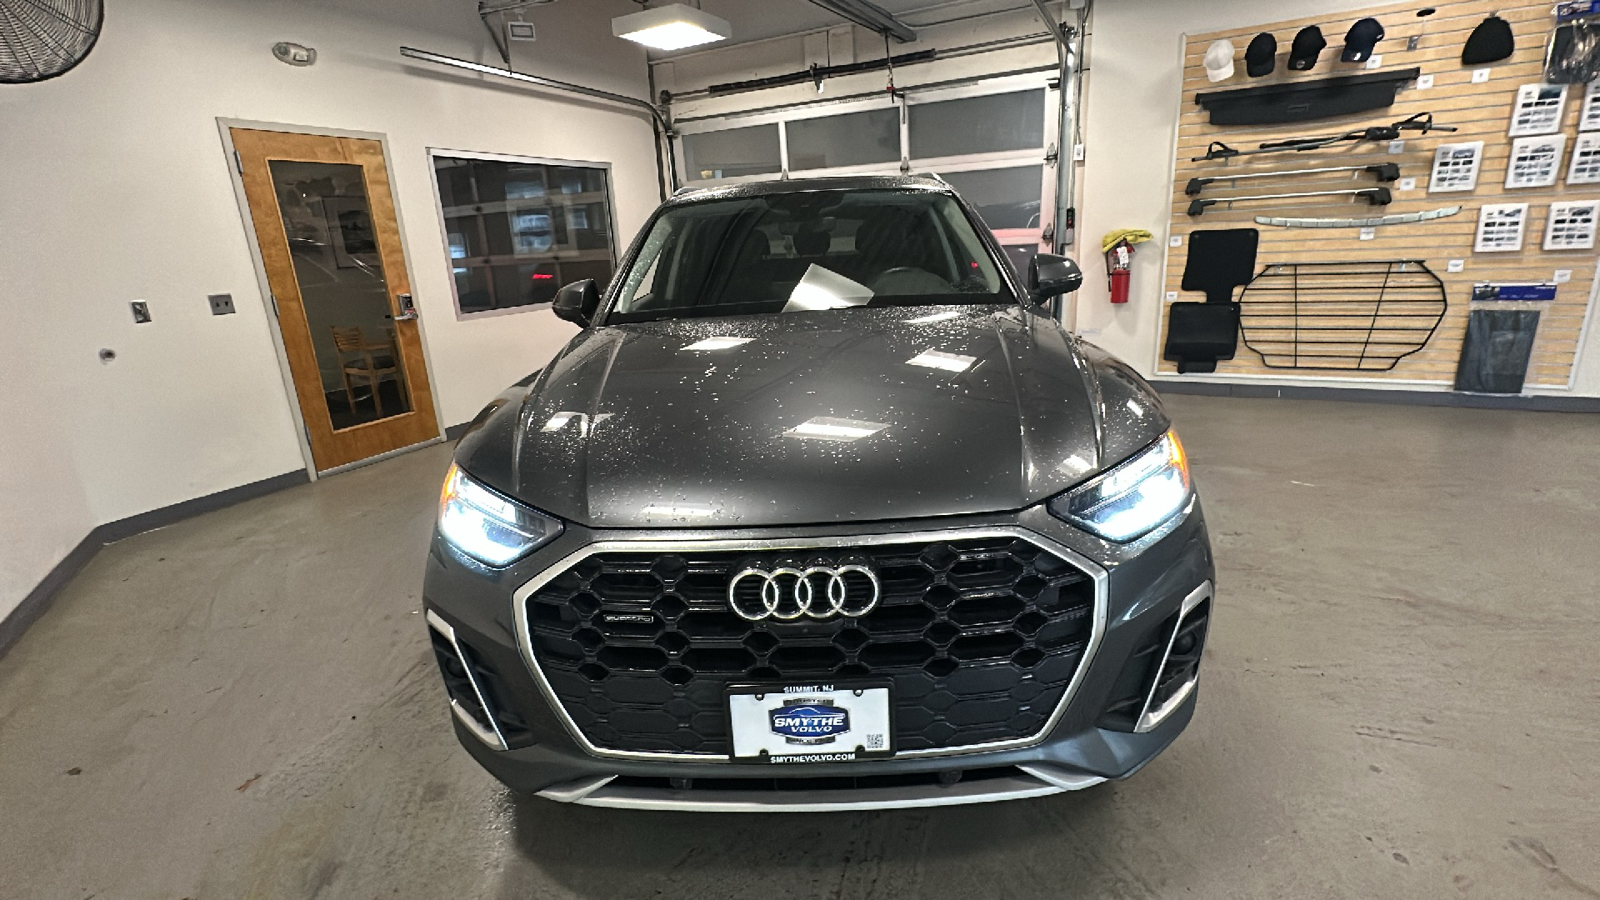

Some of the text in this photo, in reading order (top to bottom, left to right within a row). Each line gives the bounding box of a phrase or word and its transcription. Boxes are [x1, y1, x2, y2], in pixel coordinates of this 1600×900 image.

[823, 684, 834, 692] NJ
[774, 717, 844, 727] SMYTHE
[770, 753, 856, 764] SMYTHEVOLVO.COM
